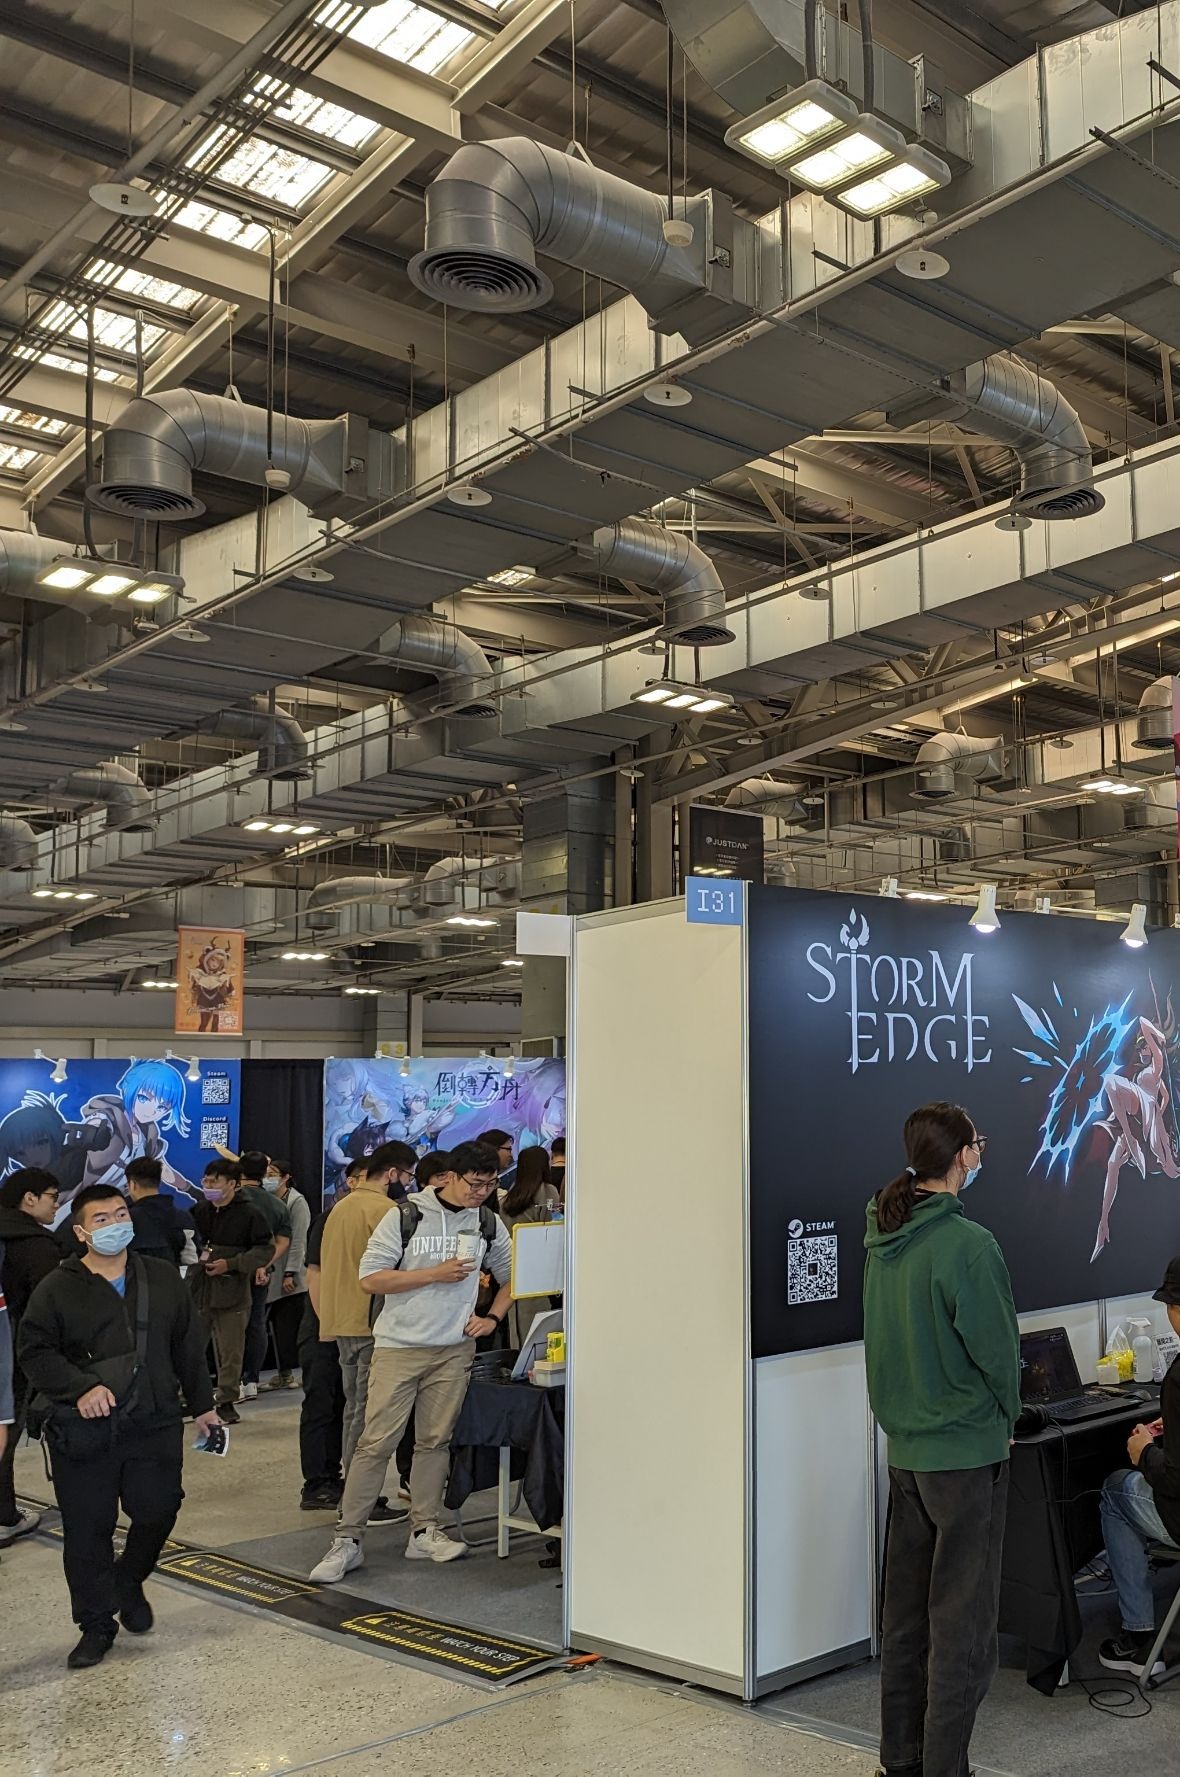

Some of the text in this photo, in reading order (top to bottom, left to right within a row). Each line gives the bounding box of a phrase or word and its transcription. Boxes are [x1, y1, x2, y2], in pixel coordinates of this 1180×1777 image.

[697, 889, 735, 914] I31
[806, 942, 974, 1018] STORM
[845, 1011, 992, 1074] EDGE
[434, 1066, 521, 1102] 倒轉方舟
[806, 1221, 835, 1232] STEAM
[439, 1637, 472, 1650] WATCH
[470, 1644, 496, 1657] YOUR
[493, 1652, 521, 1662] STEP
